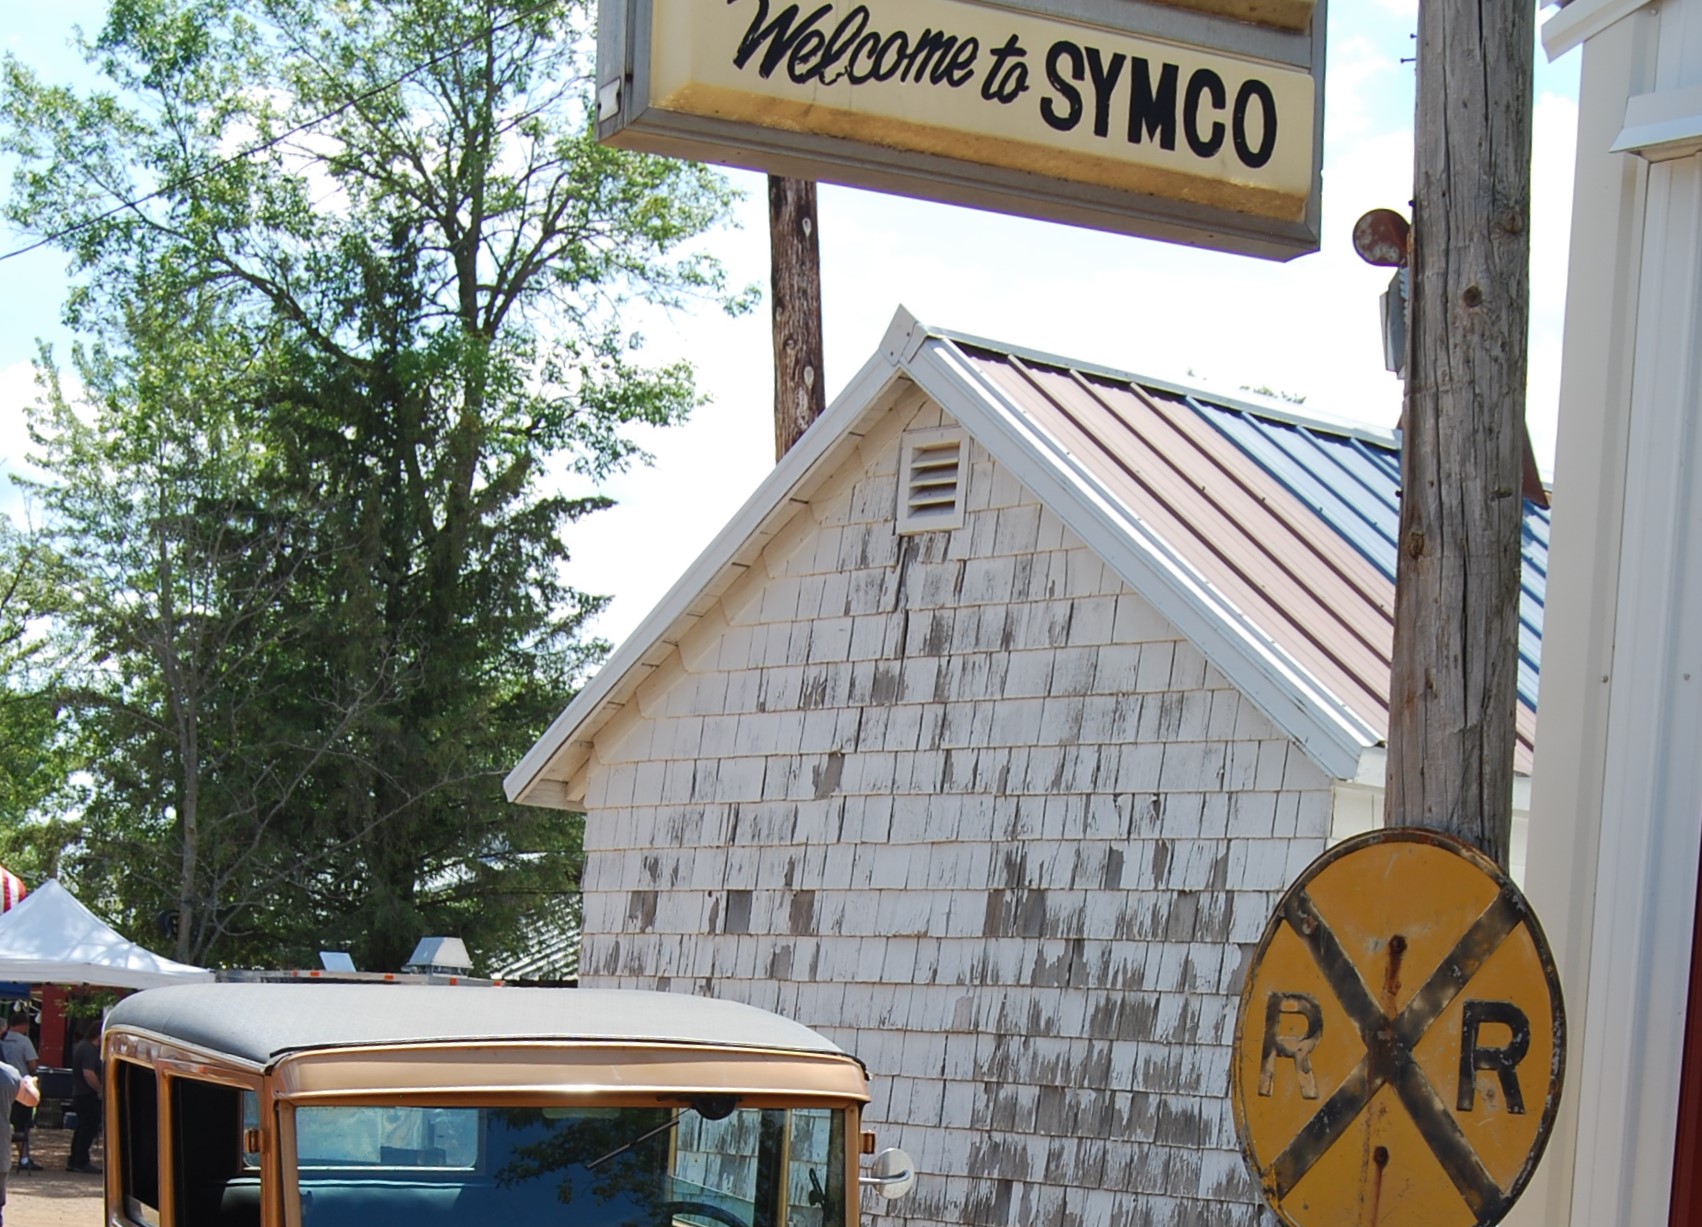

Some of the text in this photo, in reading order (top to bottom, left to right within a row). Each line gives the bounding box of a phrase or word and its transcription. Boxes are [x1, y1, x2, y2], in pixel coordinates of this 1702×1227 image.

[726, 0, 1277, 169] Welcome to SYMCO
[1257, 991, 1531, 1114] R R
